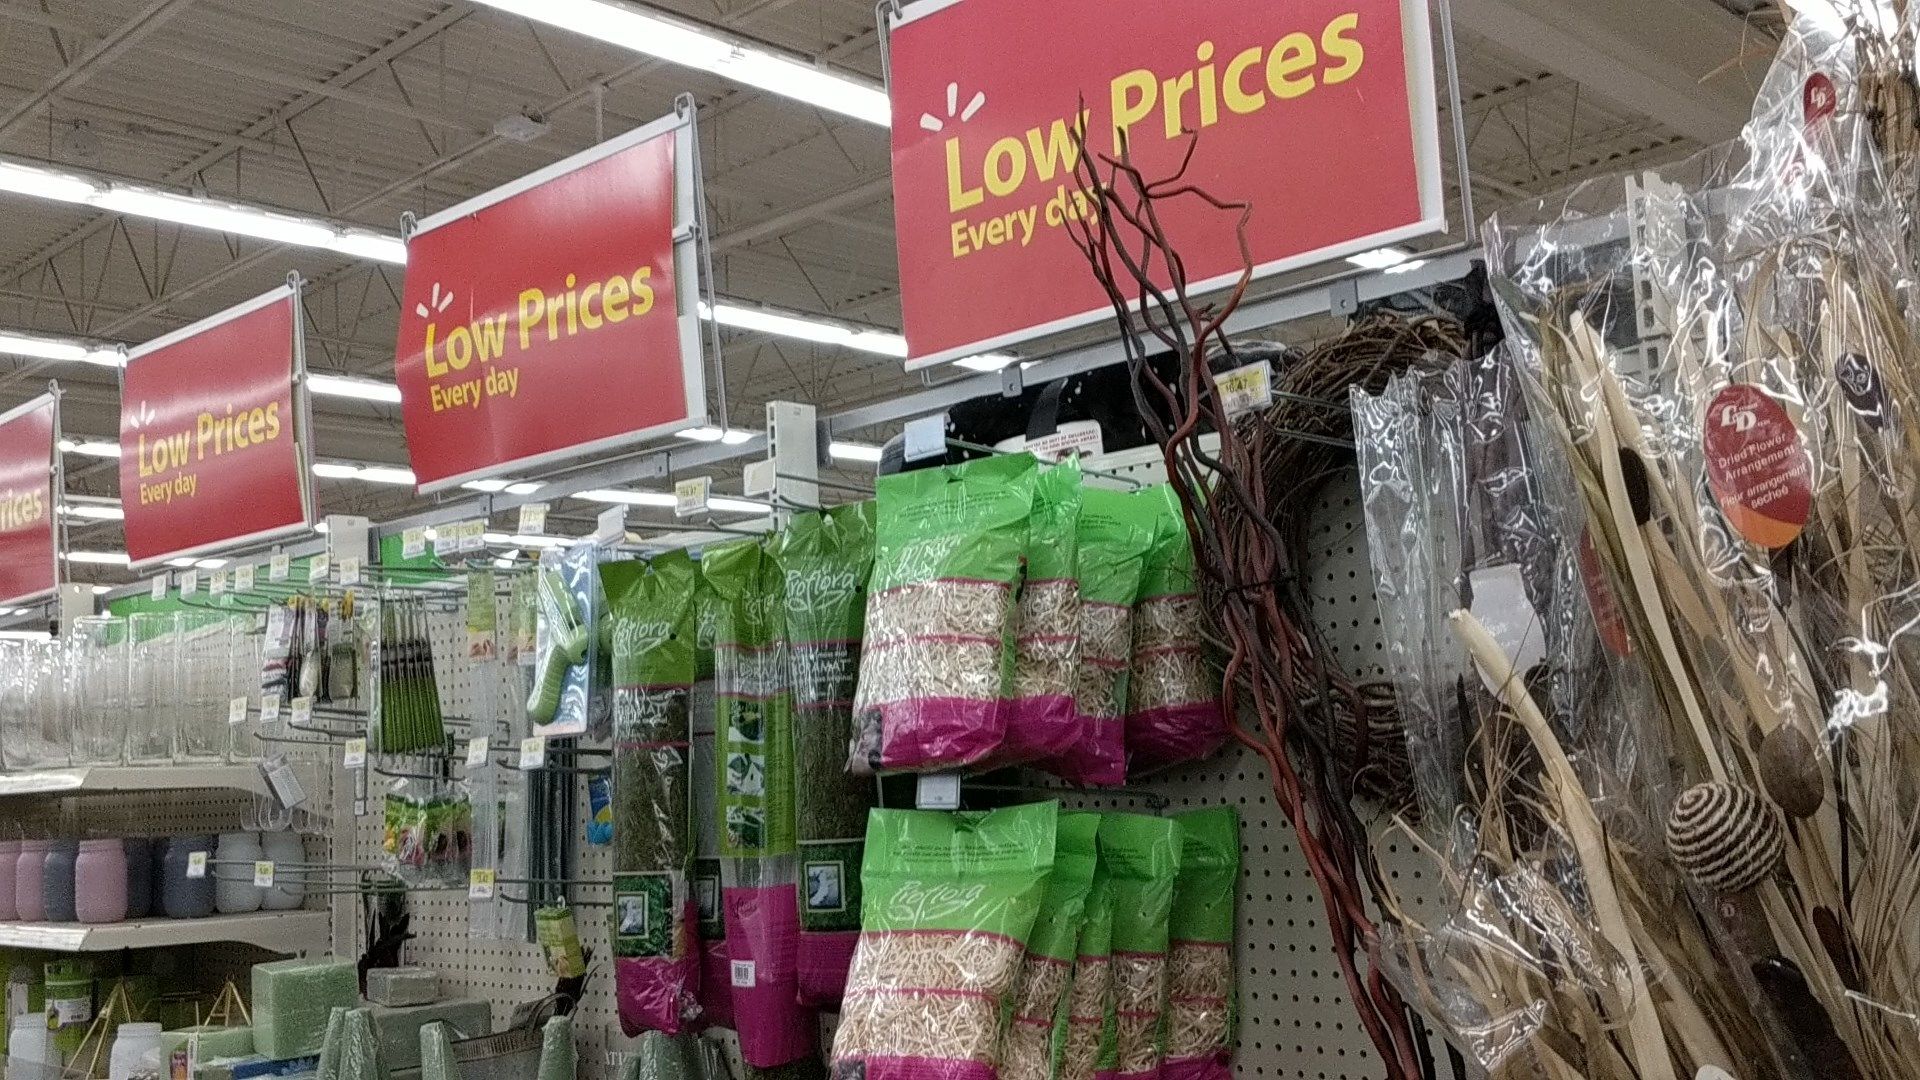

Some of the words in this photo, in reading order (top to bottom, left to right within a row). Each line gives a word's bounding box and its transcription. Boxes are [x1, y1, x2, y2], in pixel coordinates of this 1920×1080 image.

[945, 109, 1091, 213] Low
[1110, 12, 1365, 157] Prices
[950, 207, 1038, 259] Every
[1044, 181, 1108, 228] day
[424, 313, 505, 378] Low
[518, 265, 655, 350] Prices
[430, 379, 481, 412] Every
[486, 365, 519, 397] day
[138, 429, 190, 477] Low
[196, 401, 281, 461] Prices
[1718, 448, 1748, 469] Dried
[1748, 433, 1786, 455] Flower
[1725, 444, 1796, 482] Arrangement
[1747, 461, 1807, 497] arrangement
[0, 488, 43, 532] rices
[140, 477, 173, 506] Every
[175, 471, 197, 497] day
